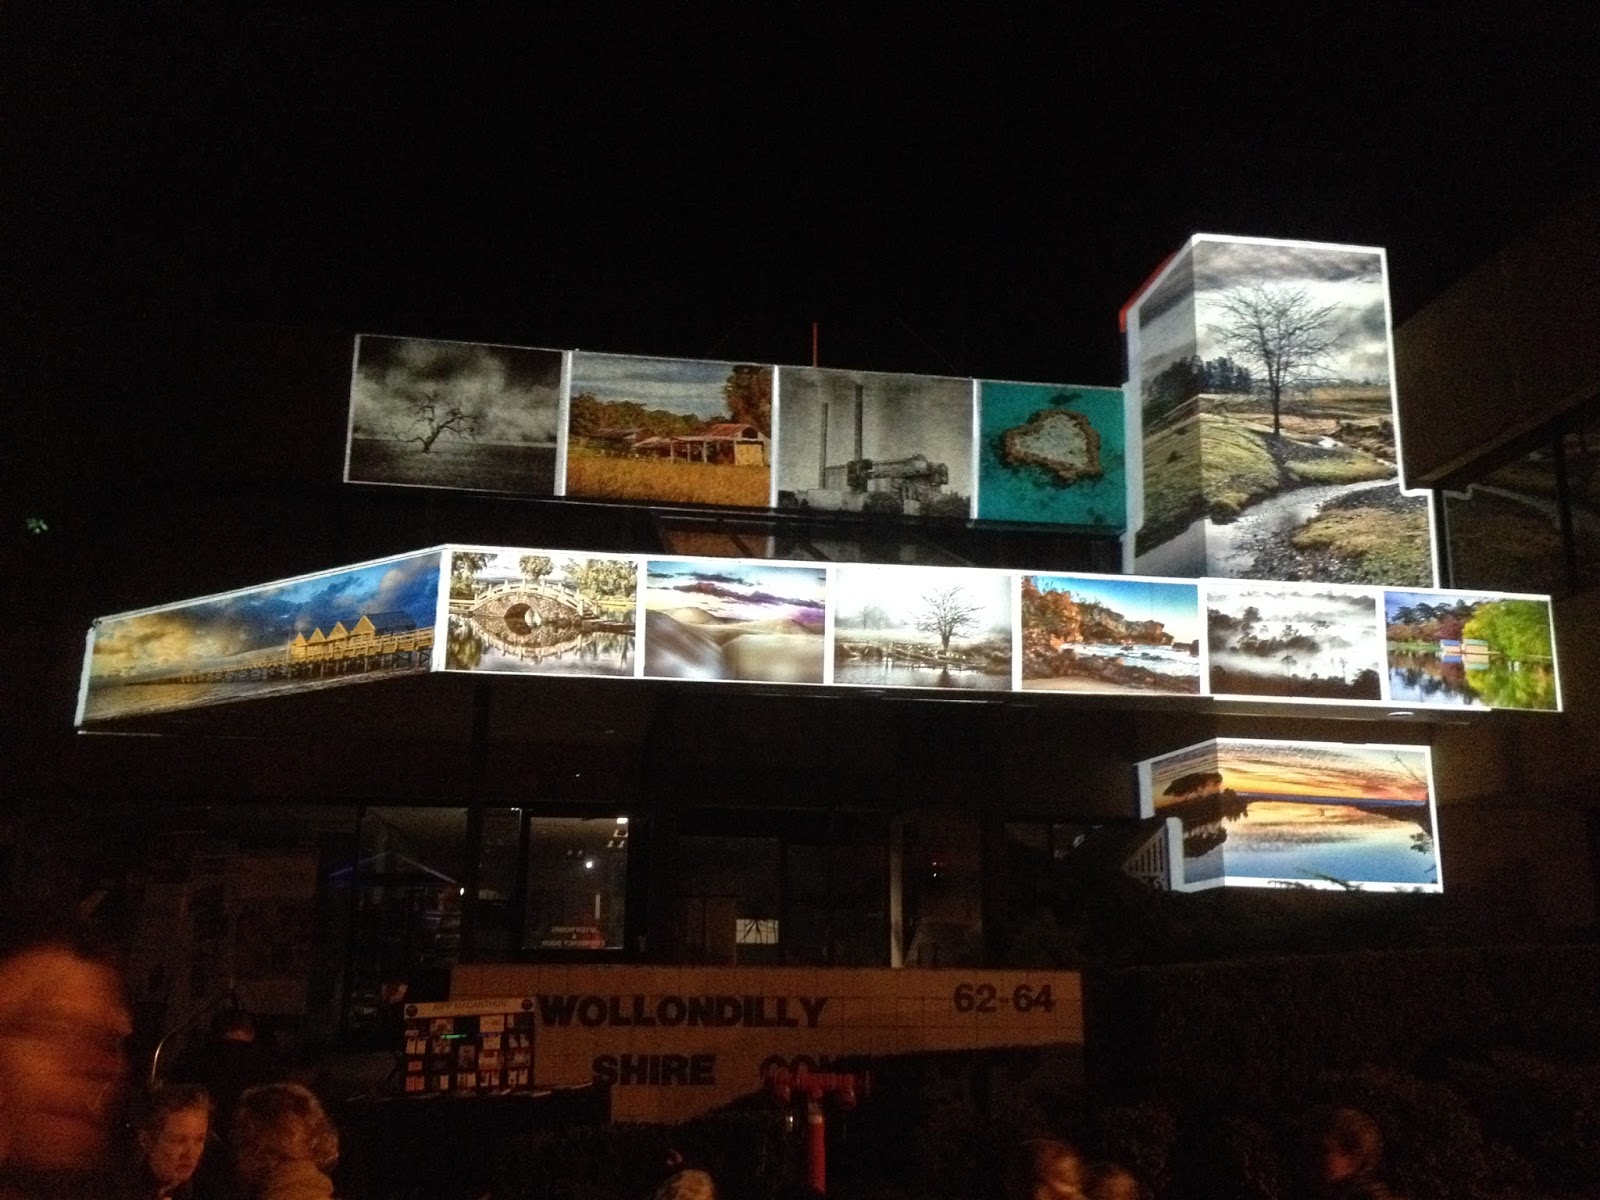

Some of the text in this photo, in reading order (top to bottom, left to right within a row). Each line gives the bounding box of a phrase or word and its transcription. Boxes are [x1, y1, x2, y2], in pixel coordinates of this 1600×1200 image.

[538, 995, 828, 1027] WOLLONDILLY
[954, 983, 1056, 1013] 62-64
[592, 1054, 717, 1086] SHIRE
